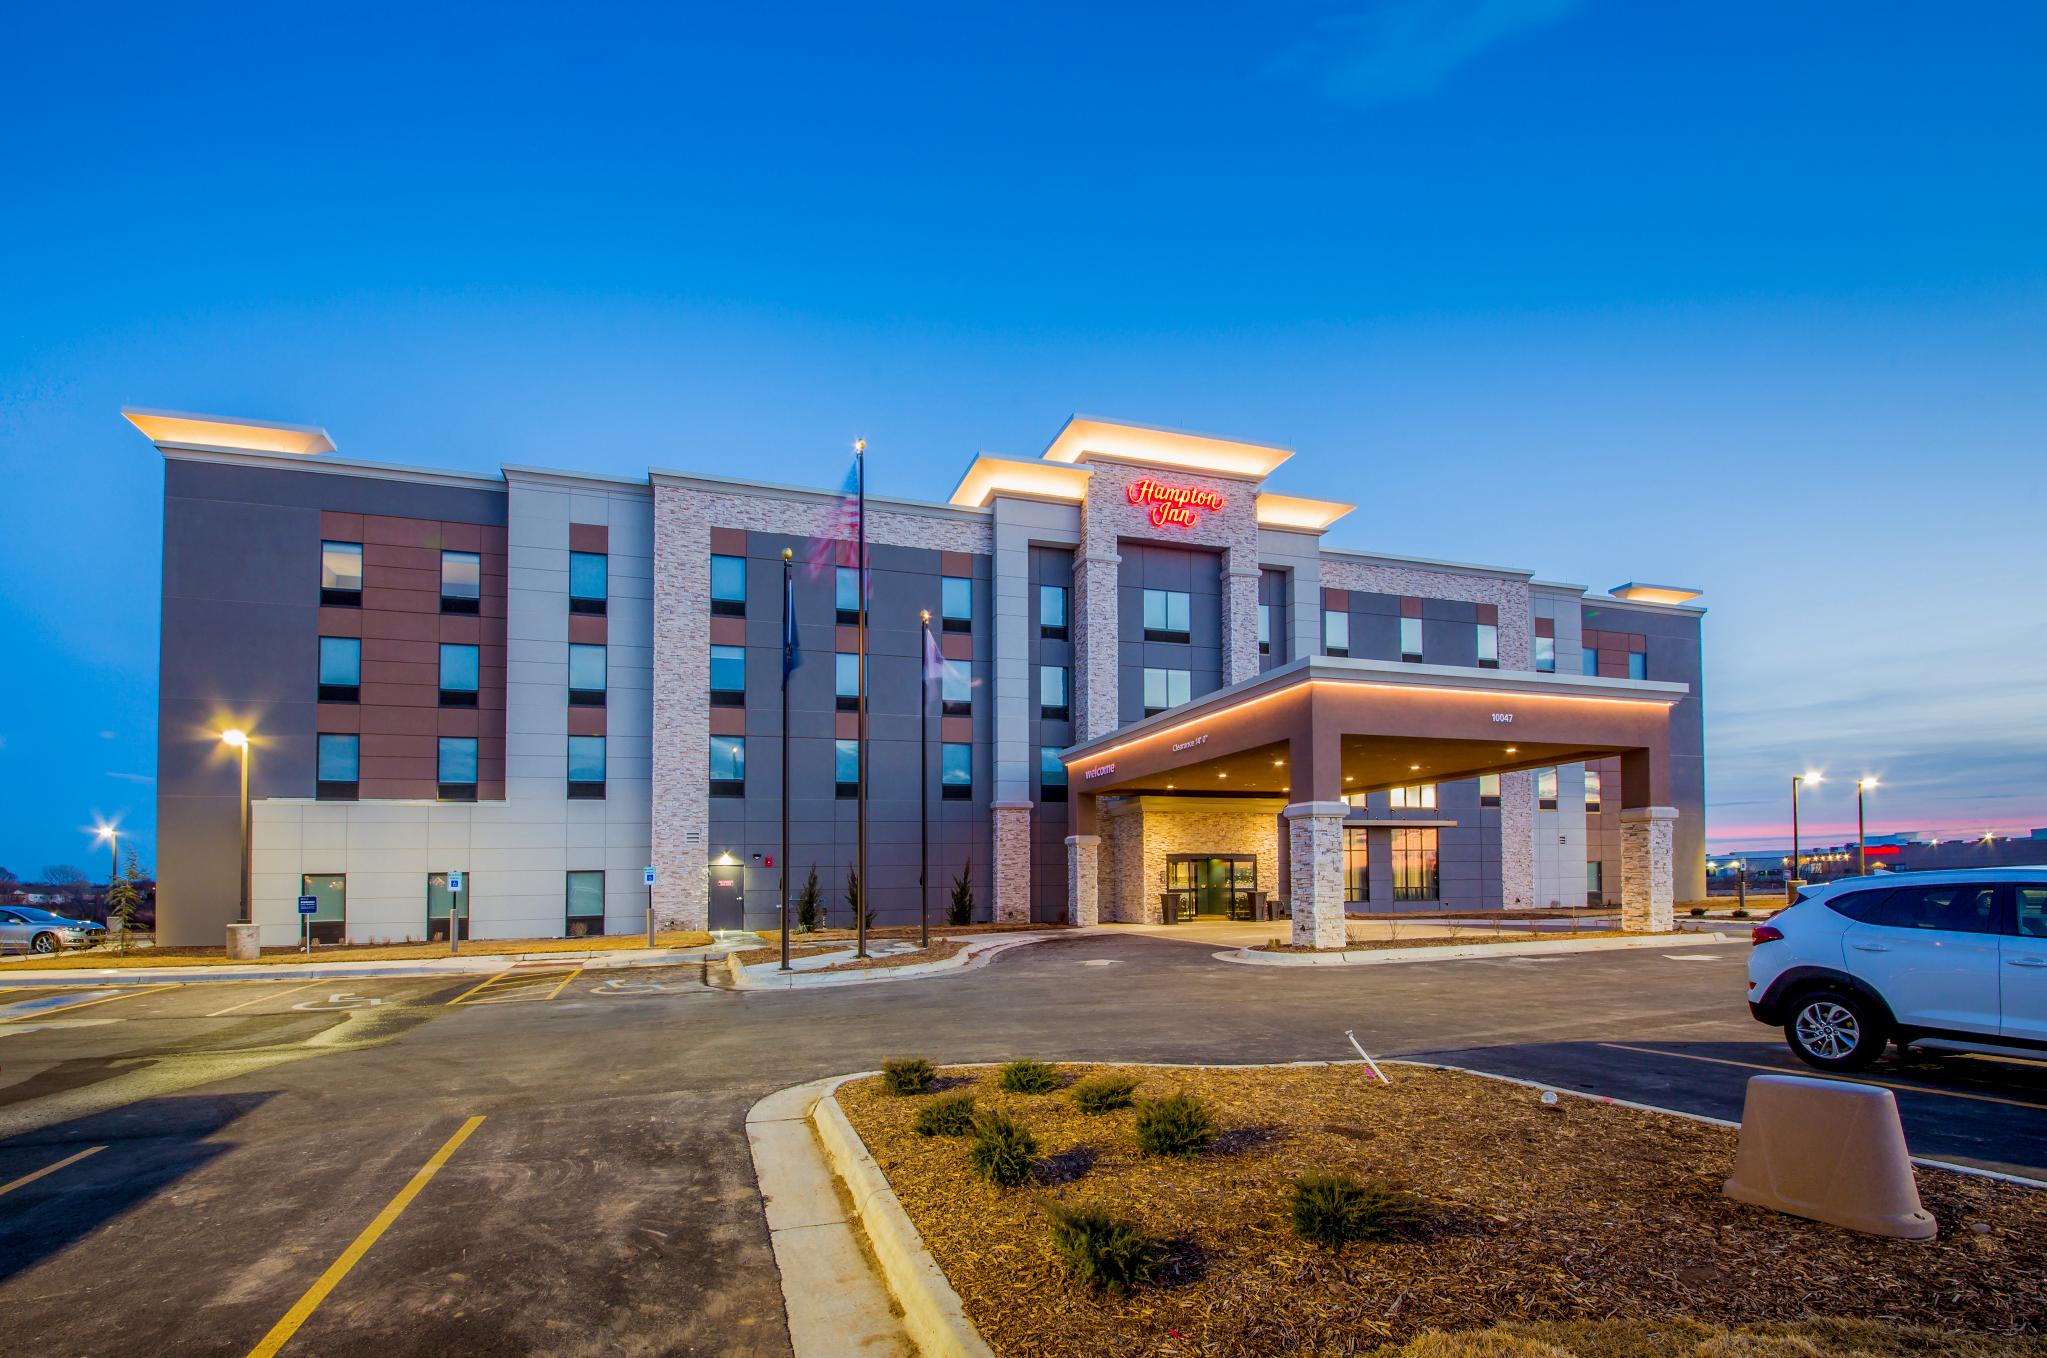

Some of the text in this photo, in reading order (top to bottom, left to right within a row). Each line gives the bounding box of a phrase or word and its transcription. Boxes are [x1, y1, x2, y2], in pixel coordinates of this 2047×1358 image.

[1128, 479, 1226, 511] Hampton
[1151, 501, 1198, 526] Inn
[1491, 713, 1513, 723] 10047
